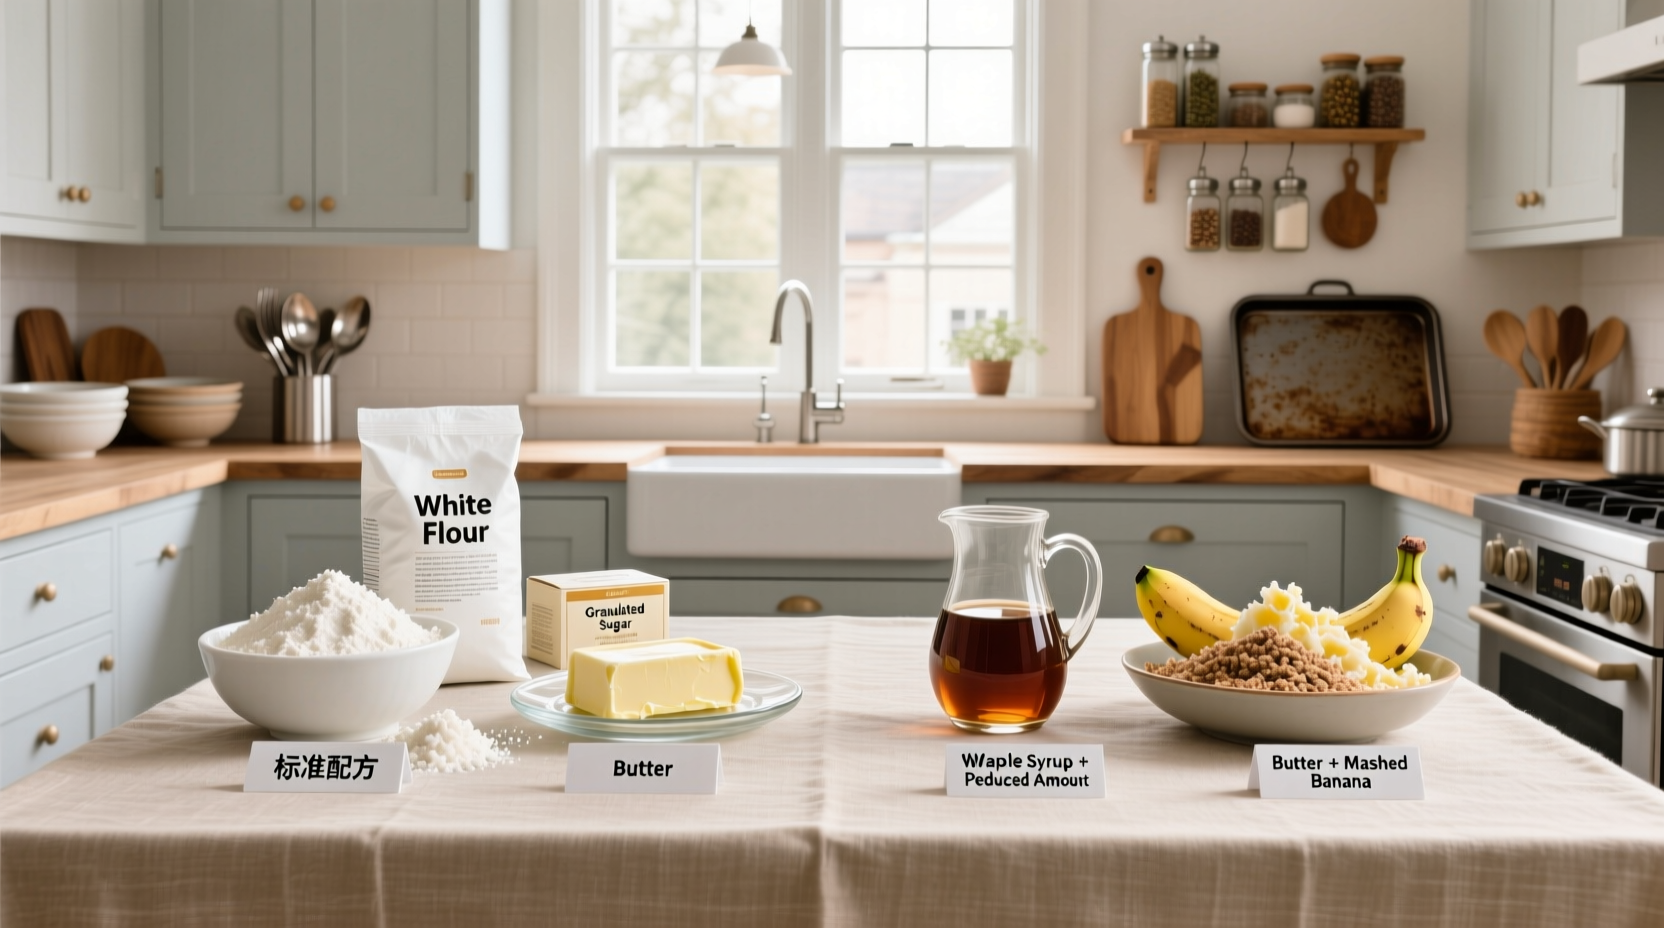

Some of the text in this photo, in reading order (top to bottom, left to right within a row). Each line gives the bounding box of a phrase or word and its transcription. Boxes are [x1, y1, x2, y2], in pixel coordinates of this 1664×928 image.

[414, 494, 492, 516] White
[423, 520, 490, 545] Flour
[599, 619, 632, 633] Sugar
[273, 753, 379, 780] 标准配方
[613, 759, 673, 777] Butter
[1027, 754, 1073, 772] Syrup
[1079, 756, 1089, 767] +
[1272, 754, 1408, 770] Butter + Mashed
[1311, 773, 1372, 789] Banana
